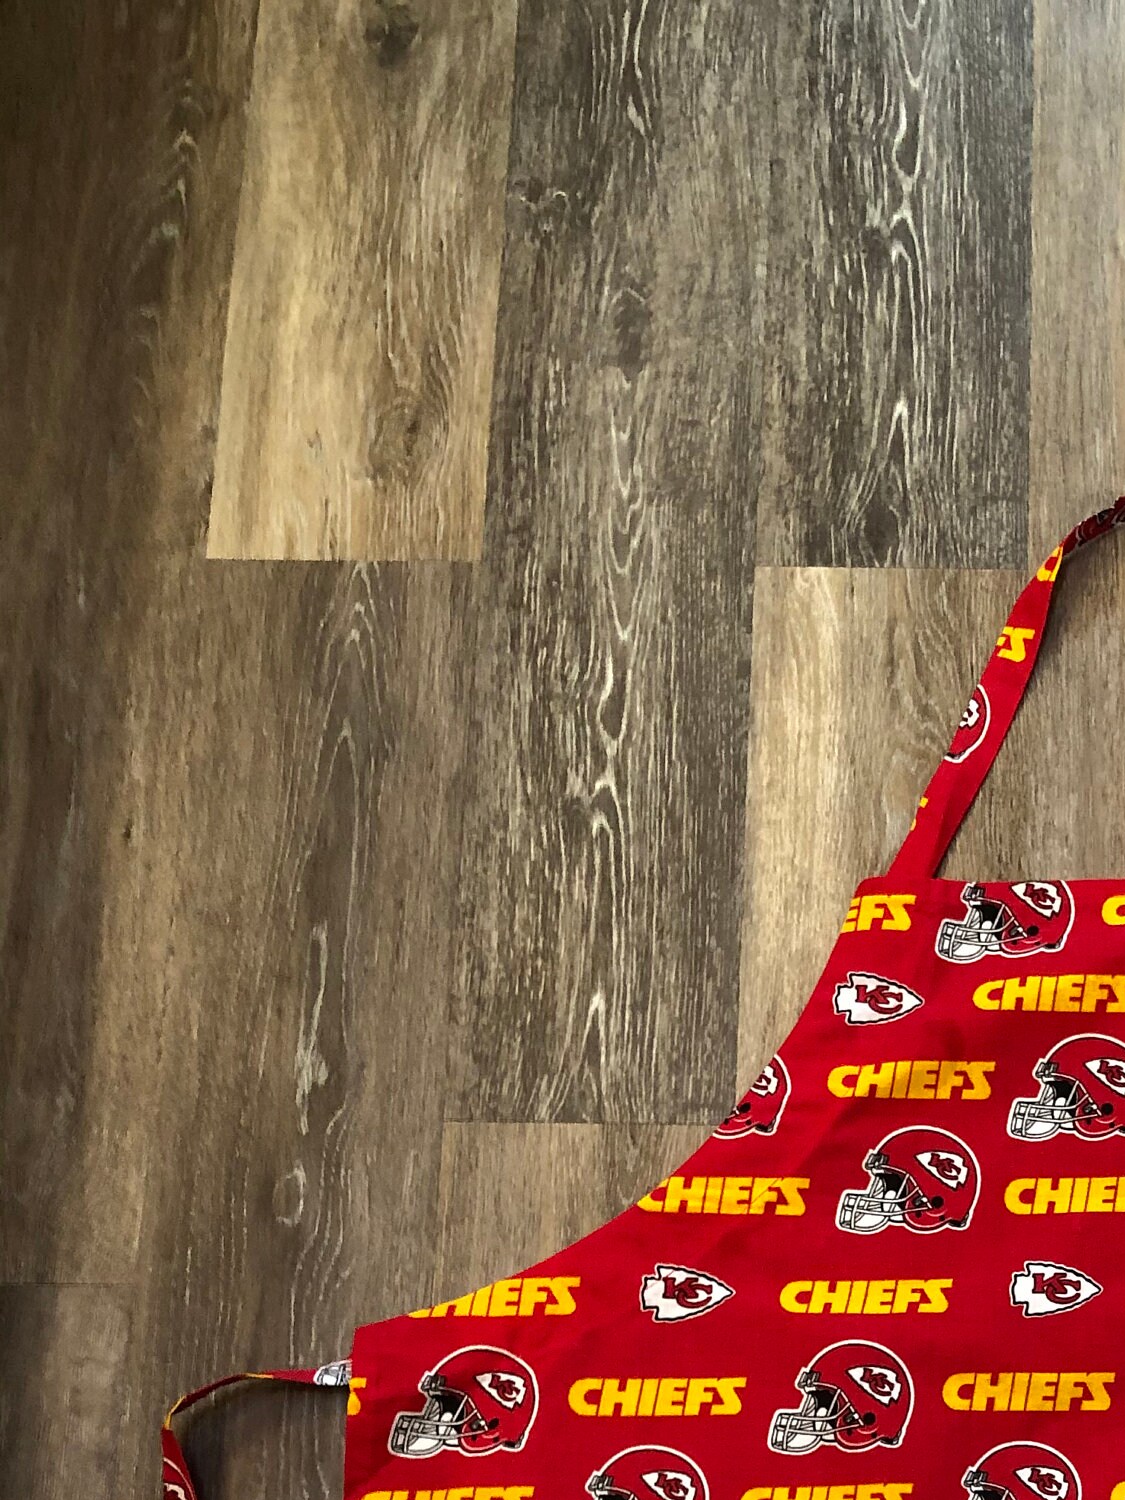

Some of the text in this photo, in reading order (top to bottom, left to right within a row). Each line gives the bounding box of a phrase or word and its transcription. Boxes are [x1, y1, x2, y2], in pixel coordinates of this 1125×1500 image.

[855, 985, 902, 1014] KC
[827, 1060, 996, 1100] CHIEFS
[663, 1276, 712, 1308] KC
[779, 1278, 953, 1315] CHIEFS
[1032, 1273, 1081, 1304] KC
[568, 1377, 747, 1417] CHIEFS
[942, 1372, 1115, 1412] CHIEFS
